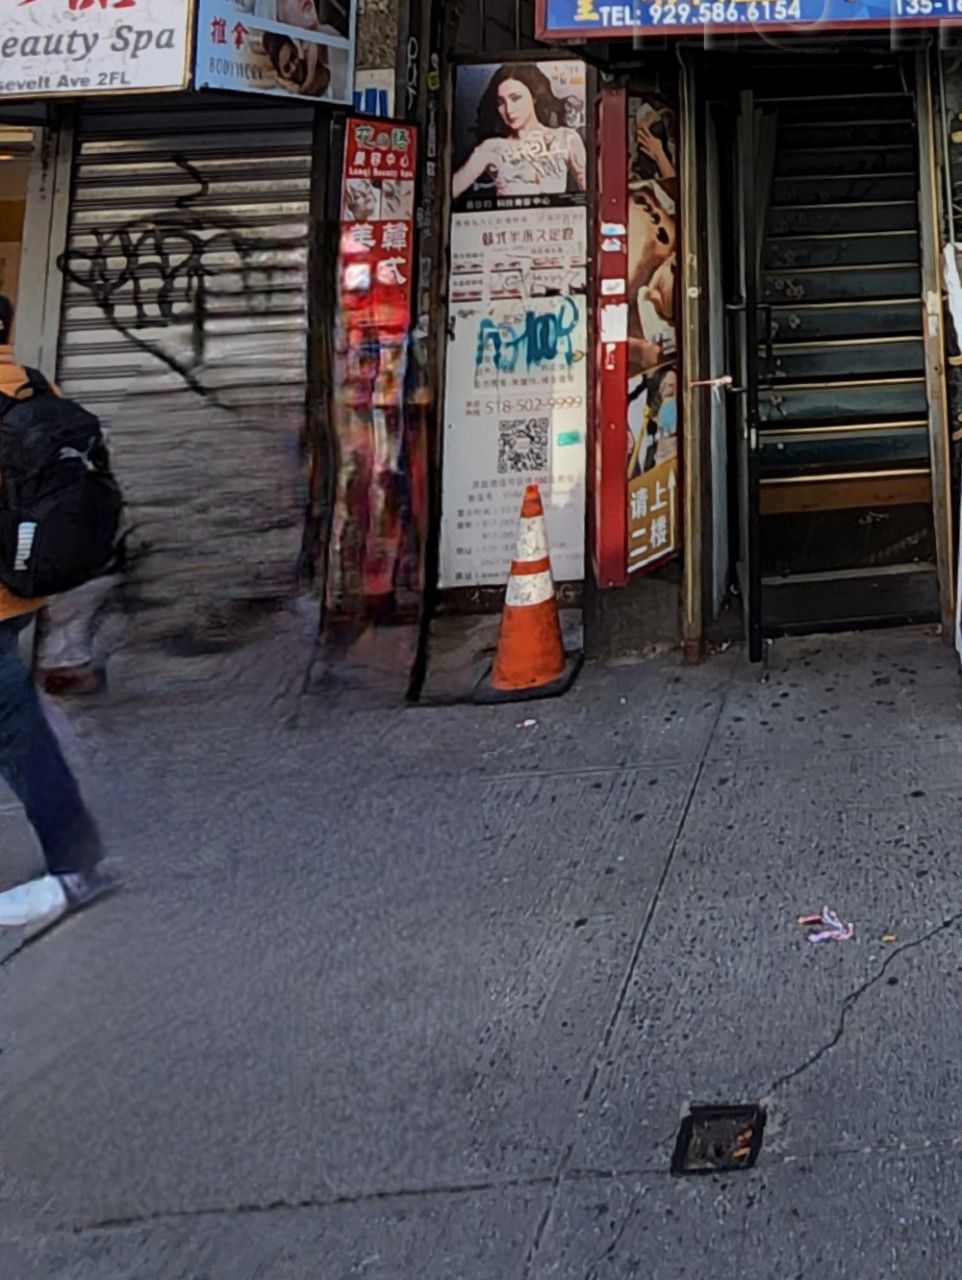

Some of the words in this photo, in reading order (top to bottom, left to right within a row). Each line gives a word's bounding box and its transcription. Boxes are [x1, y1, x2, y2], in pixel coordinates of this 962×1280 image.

[599, 4, 641, 28] TEL:
[1, 30, 99, 62] eauty
[110, 24, 176, 59] Spa
[56, 73, 91, 89] Ave
[96, 71, 131, 87] 2FL
